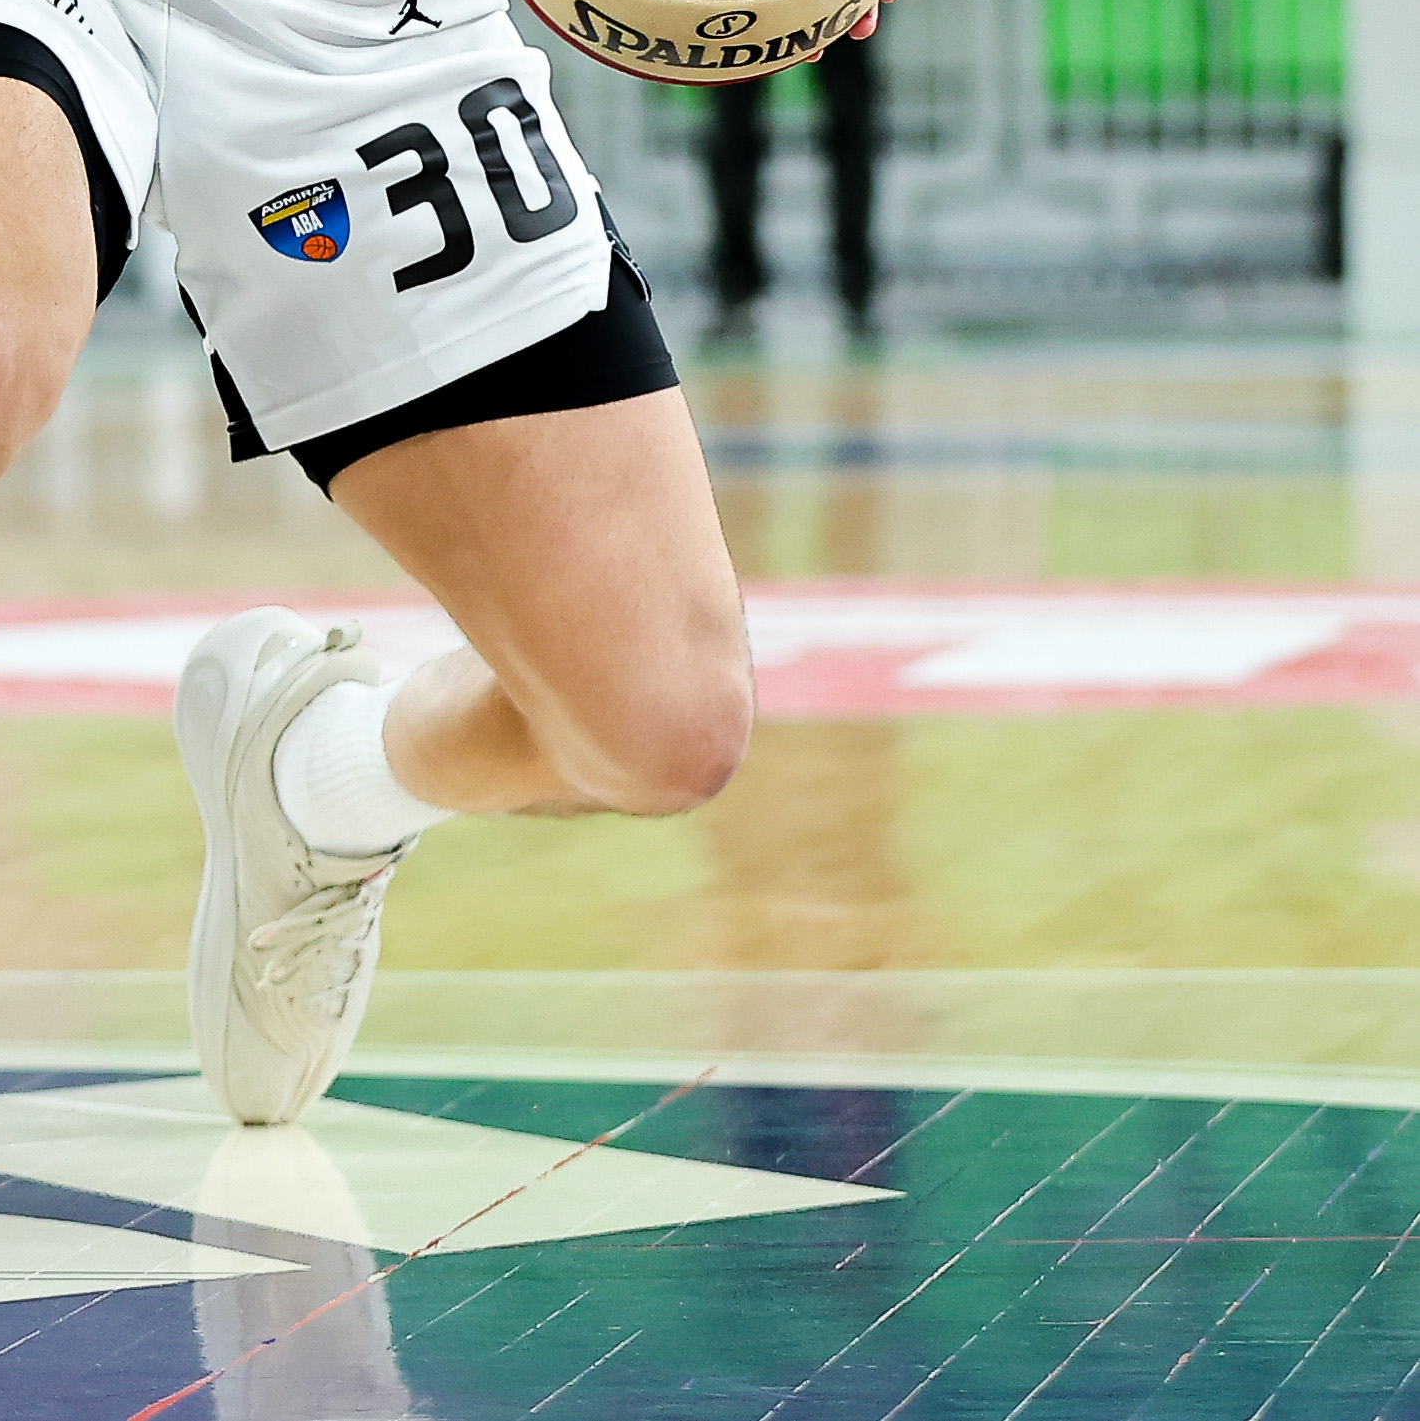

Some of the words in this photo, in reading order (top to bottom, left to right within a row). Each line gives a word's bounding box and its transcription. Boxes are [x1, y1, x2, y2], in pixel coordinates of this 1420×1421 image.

[261, 183, 334, 217] ADMIRAL
[355, 76, 578, 294] 30
[291, 209, 324, 238] ABA
